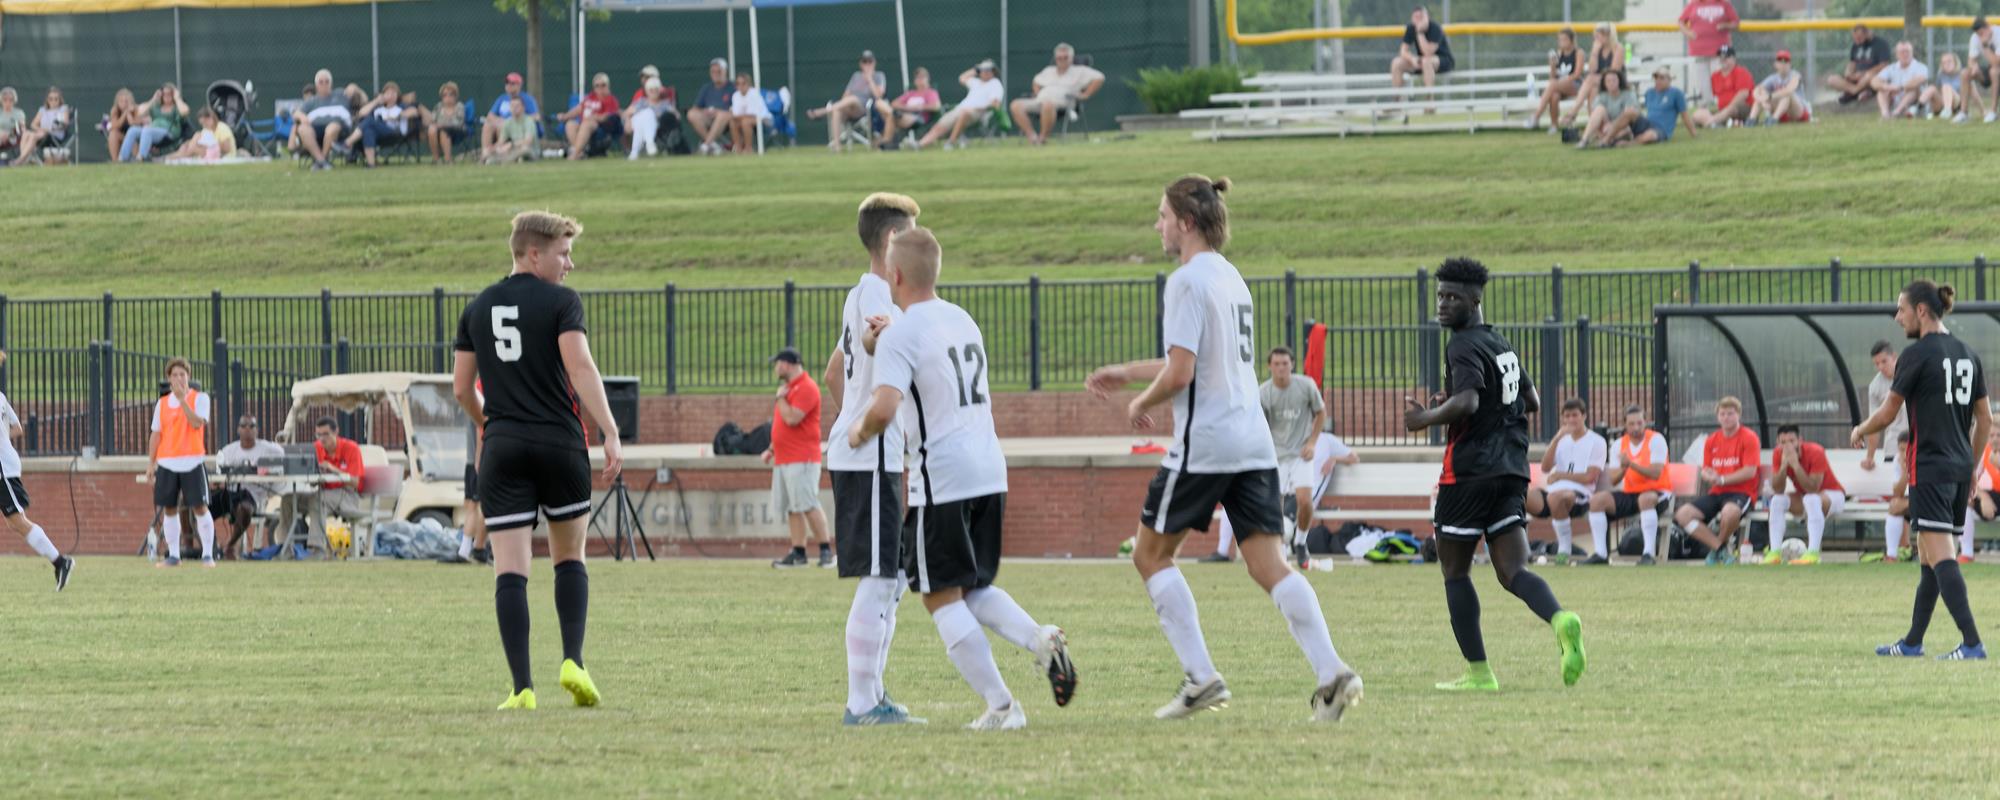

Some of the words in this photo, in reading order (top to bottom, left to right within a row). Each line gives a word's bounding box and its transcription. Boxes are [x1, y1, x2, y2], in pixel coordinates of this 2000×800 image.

[491, 305, 522, 362] 5
[947, 343, 987, 407] 12
[1942, 357, 1974, 406] 13
